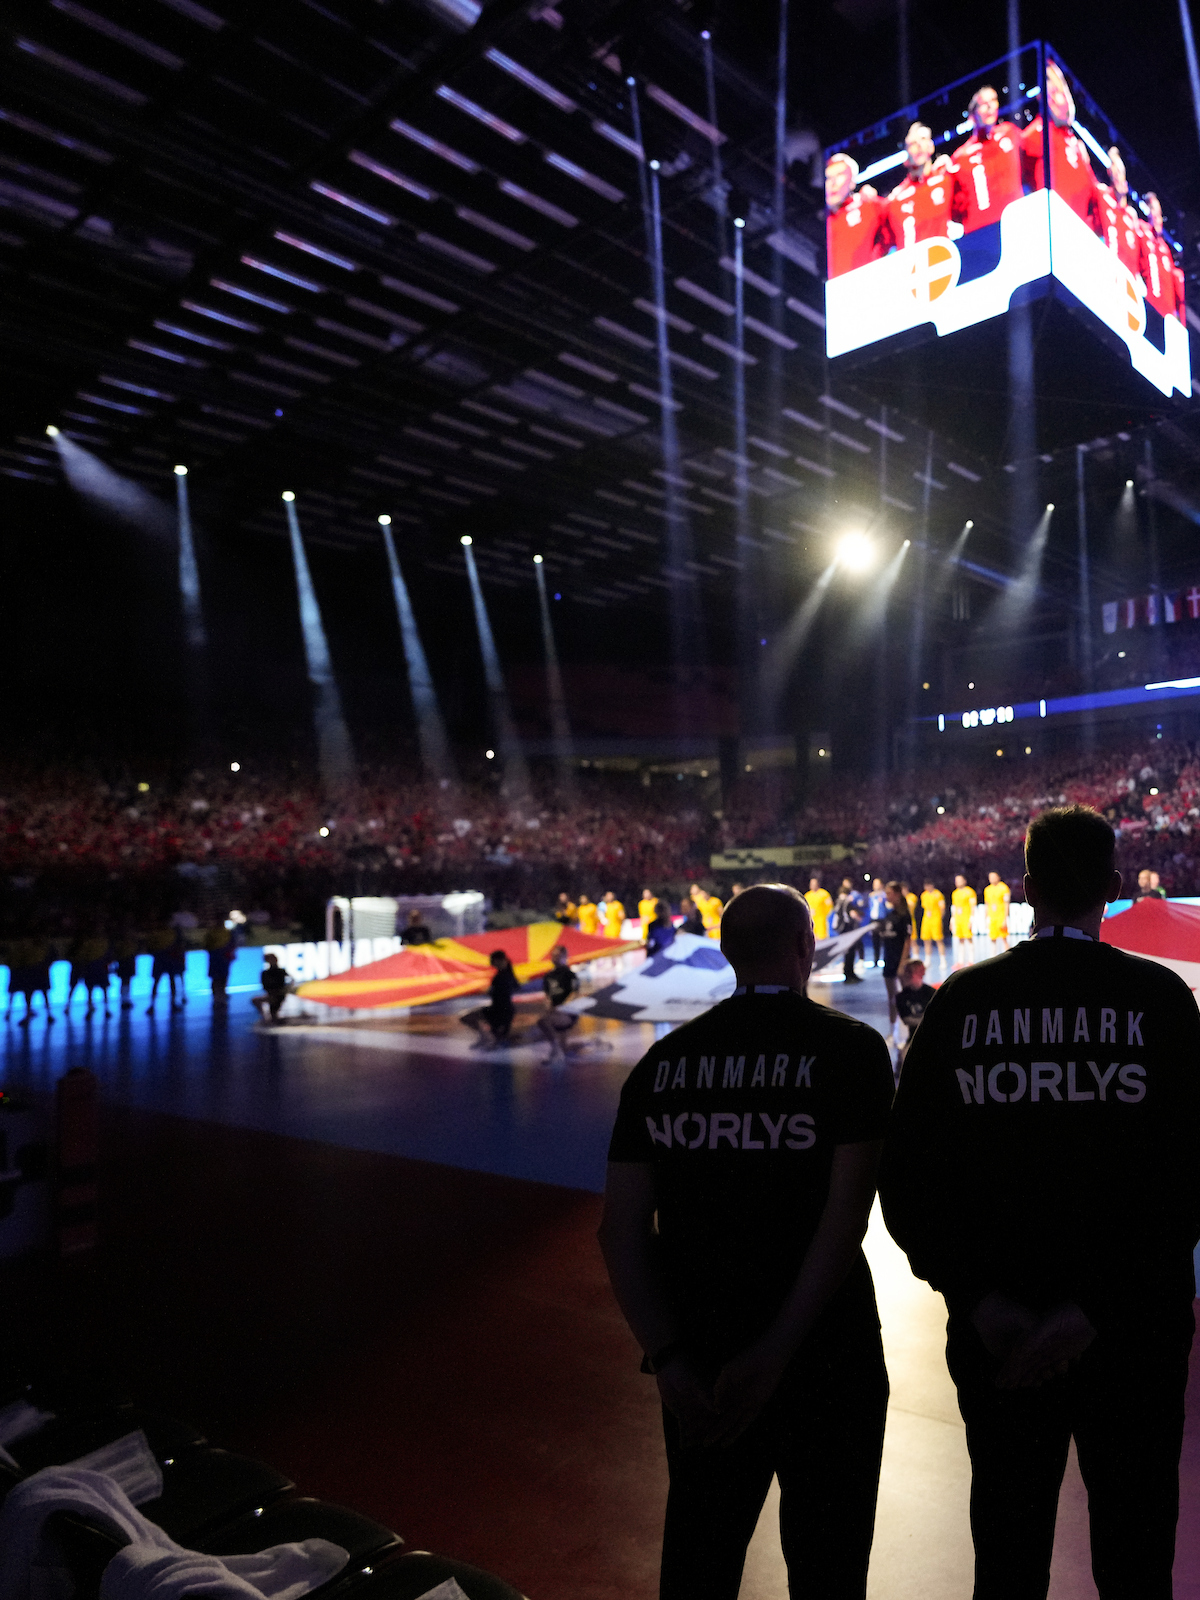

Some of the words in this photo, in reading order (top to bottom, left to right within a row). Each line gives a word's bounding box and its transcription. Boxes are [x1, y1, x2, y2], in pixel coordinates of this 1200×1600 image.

[961, 1006, 1145, 1050] DANMARK
[653, 1053, 817, 1093] DANMARK
[955, 1060, 1147, 1104] NORLYS
[645, 1112, 817, 1150] NORLYS
